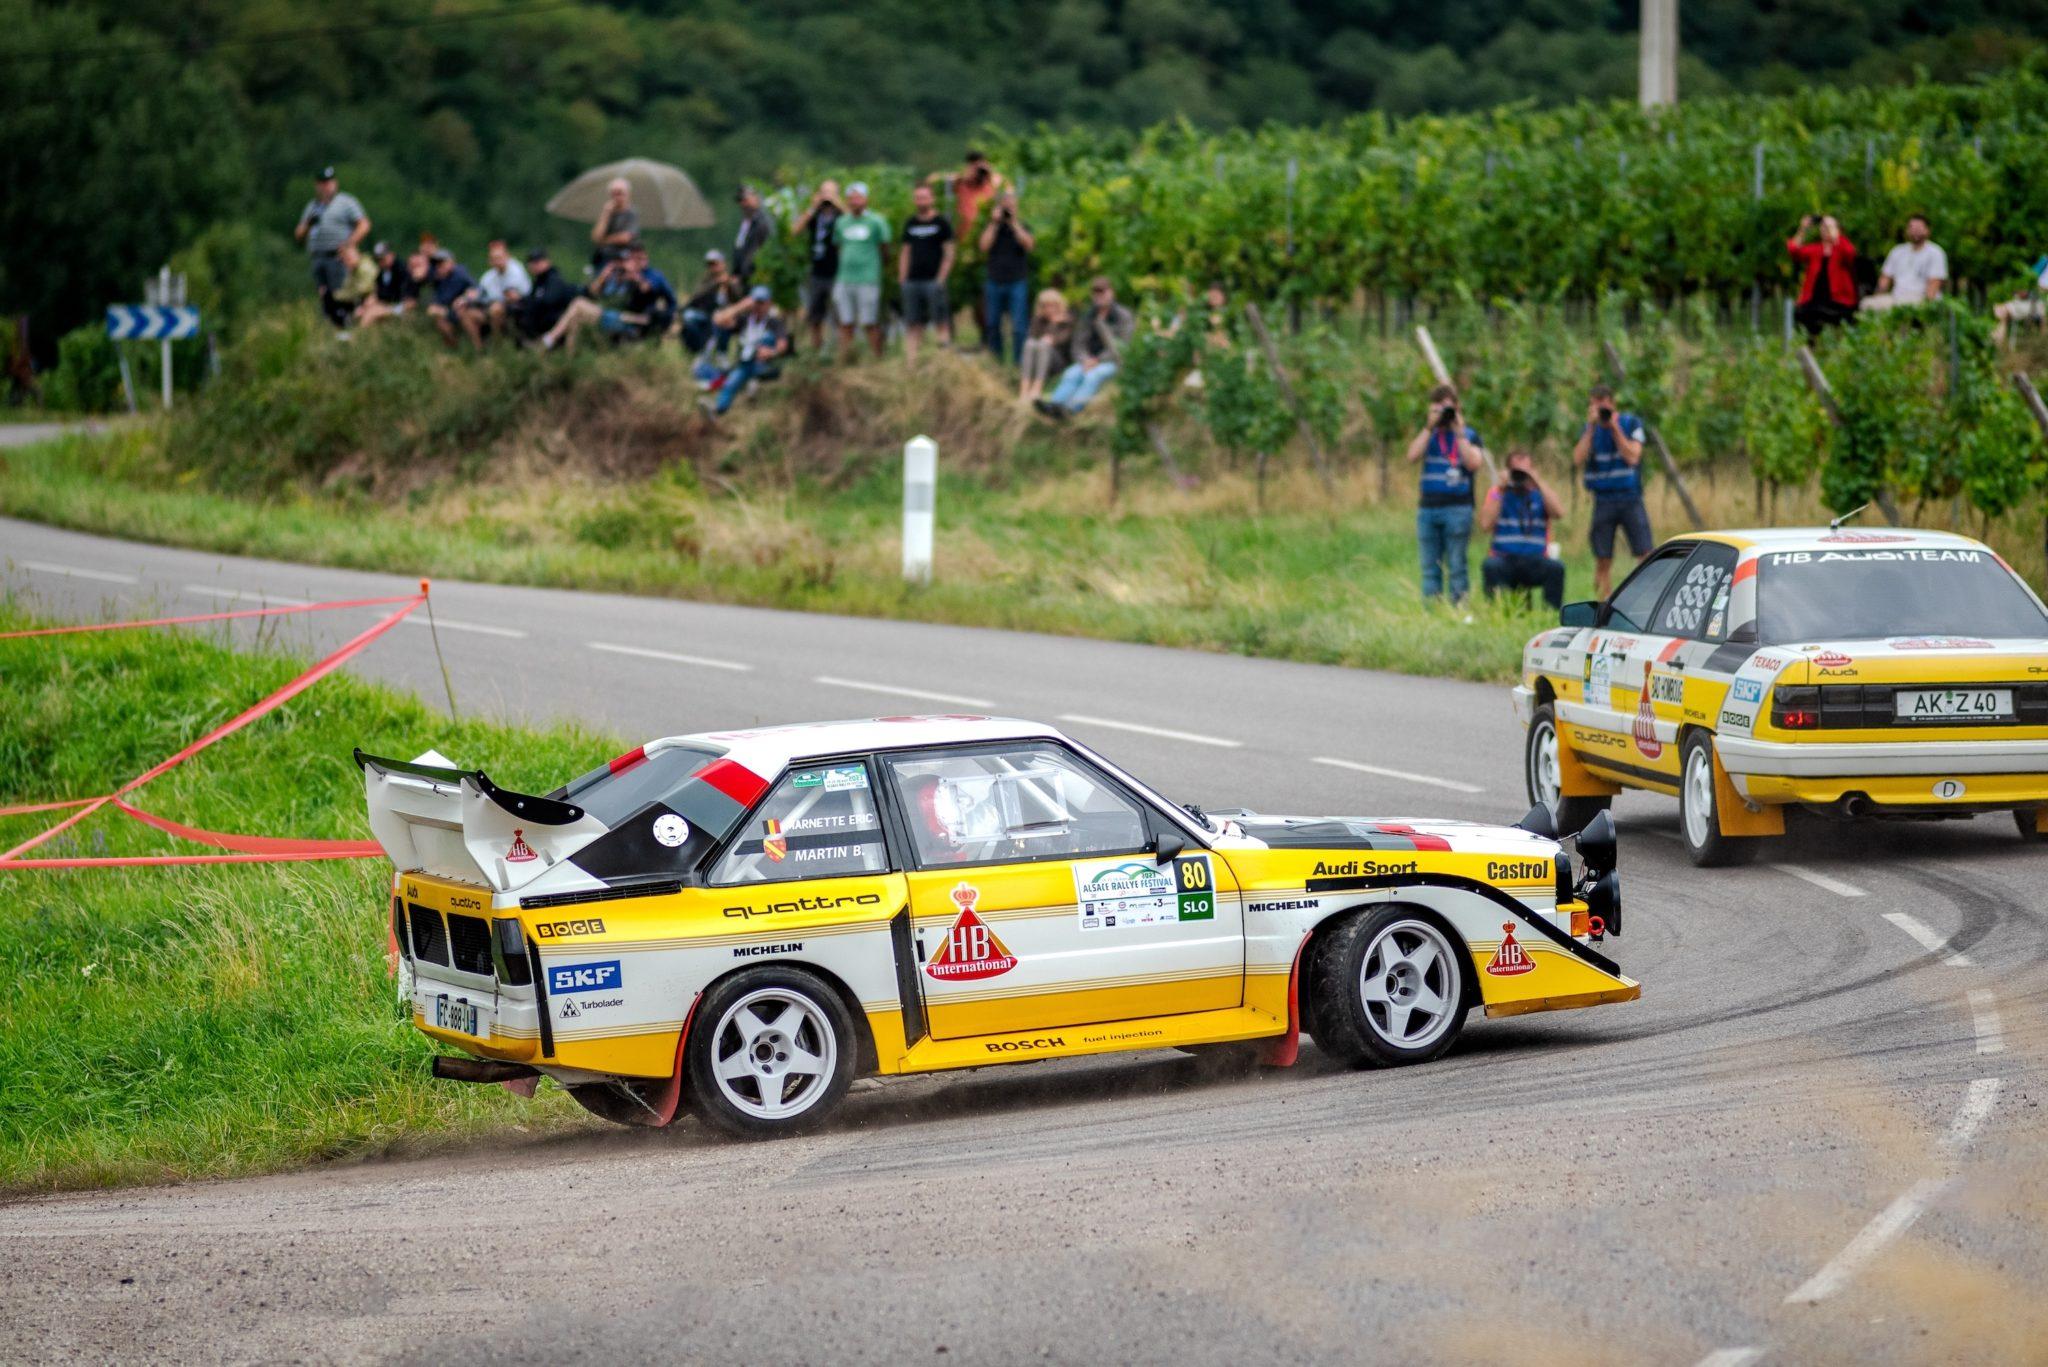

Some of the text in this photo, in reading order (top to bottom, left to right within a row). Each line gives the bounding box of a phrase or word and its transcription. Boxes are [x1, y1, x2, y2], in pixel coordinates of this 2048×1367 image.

[1772, 553, 1812, 566] HB
[1751, 656, 1782, 671] TEXACO
[1817, 668, 1858, 676] Audi
[1734, 680, 1759, 701] SKF
[1974, 692, 1996, 712] 40
[1723, 712, 1750, 727] BOGE
[1574, 731, 1627, 748] quattro
[1943, 781, 1957, 797] D
[849, 813, 873, 825] ERIC
[512, 843, 528, 857] HB
[795, 846, 865, 862] MARTIN B.
[1182, 861, 1206, 889] 80
[1313, 861, 1418, 875] Audi Sport
[1487, 860, 1548, 880] Castrol
[1083, 882, 1109, 893] ALSACE
[1111, 880, 1139, 890] RALLYE
[1140, 877, 1173, 888] FESTIVAL
[450, 897, 481, 910] quattro
[723, 893, 881, 919] quattro
[1183, 900, 1208, 914] SLO
[1249, 900, 1319, 912] MICHELIN
[539, 920, 603, 937] BOGE
[733, 943, 803, 957] MICHELIN
[947, 924, 990, 963] HB
[1499, 944, 1522, 966] HB
[932, 957, 1012, 976] international
[555, 966, 615, 989] SKF
[580, 999, 624, 1010] Turbolader
[1083, 1029, 1163, 1043] fuel injection
[985, 1037, 1066, 1053] BOSCH
